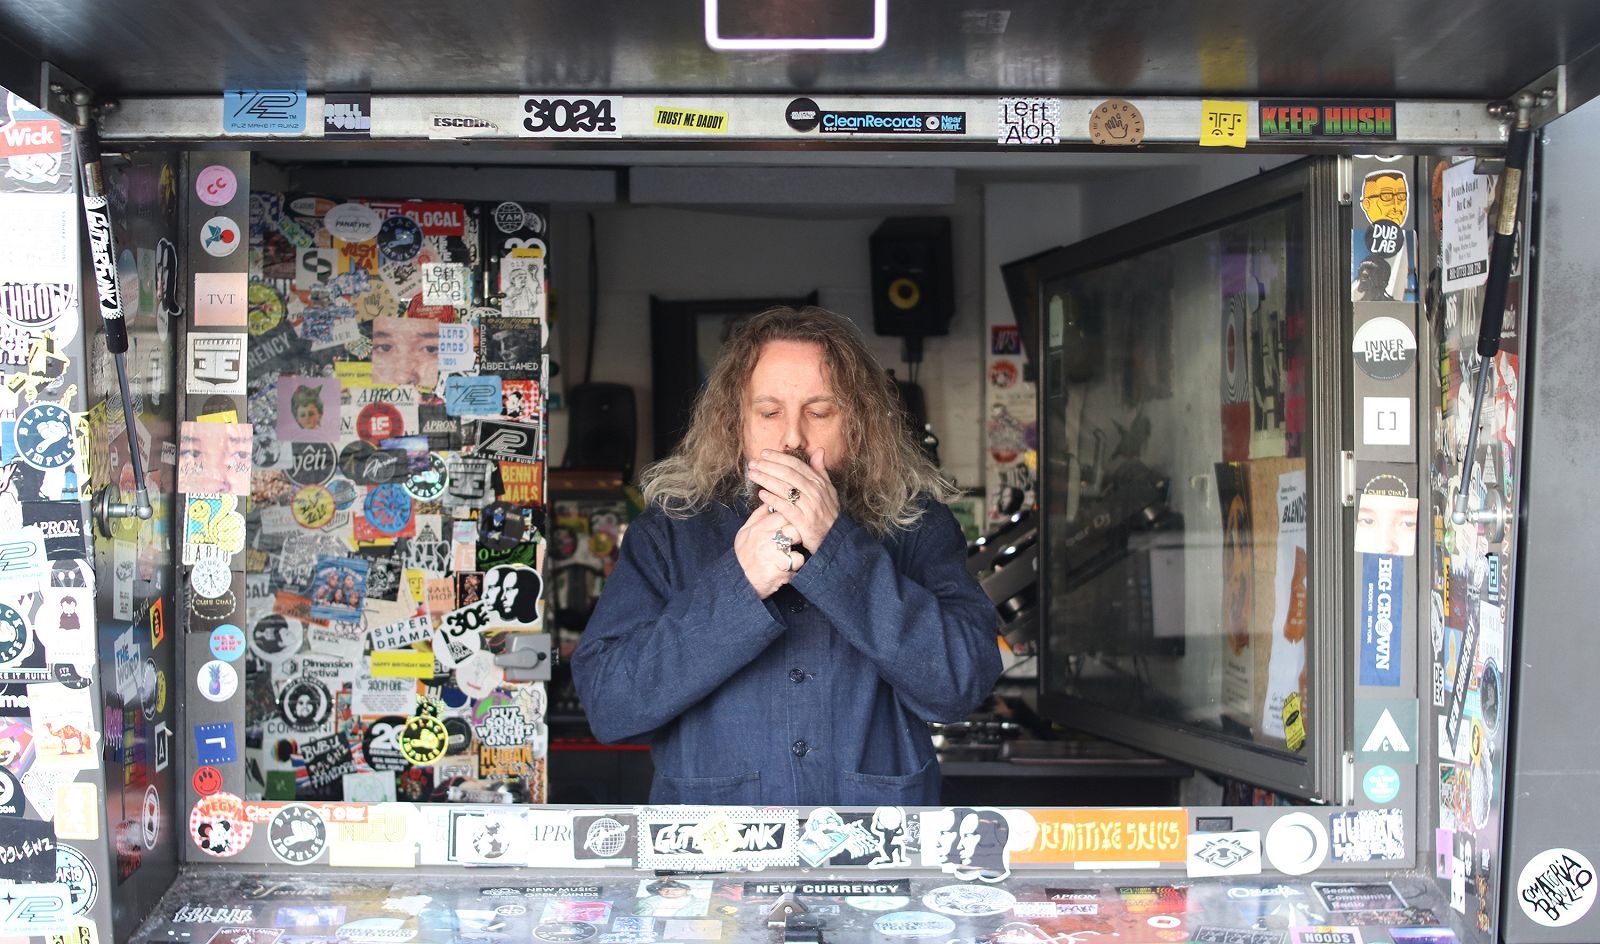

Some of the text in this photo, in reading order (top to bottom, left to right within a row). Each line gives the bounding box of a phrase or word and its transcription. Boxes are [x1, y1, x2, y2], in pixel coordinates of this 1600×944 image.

[523, 98, 616, 132] 3024
[657, 110, 724, 129] TRUST ME DADDY
[823, 114, 922, 128] CleanRecords
[941, 115, 962, 123] Near
[1004, 101, 1048, 125] Left
[1261, 106, 1393, 135] KEEP HUSH
[4, 126, 54, 147] Wick
[420, 211, 461, 227] LOCAL
[1373, 224, 1398, 240] DUB
[1370, 238, 1397, 254] LAB
[426, 265, 456, 282] Left
[207, 294, 236, 305] TVT
[1364, 338, 1404, 351] INNER
[1364, 350, 1406, 362] PEACE
[19, 406, 68, 436] BLACK
[292, 445, 327, 477] yêti
[502, 464, 539, 482] BENNY
[1375, 558, 1393, 671] BIG CROWN
[374, 617, 428, 638] SUPER
[376, 631, 431, 649] DRAMA
[302, 659, 353, 669] Dimension
[490, 707, 519, 718] PUT
[486, 716, 523, 727] SOME
[476, 724, 534, 737] WEIGHT
[487, 735, 523, 746] ON IT
[275, 807, 322, 827] BLACK
[529, 825, 574, 842] APR
[273, 837, 324, 861] IMPULSE
[756, 885, 899, 893] NEW CURRENCY
[1304, 933, 1350, 943] NOODS
